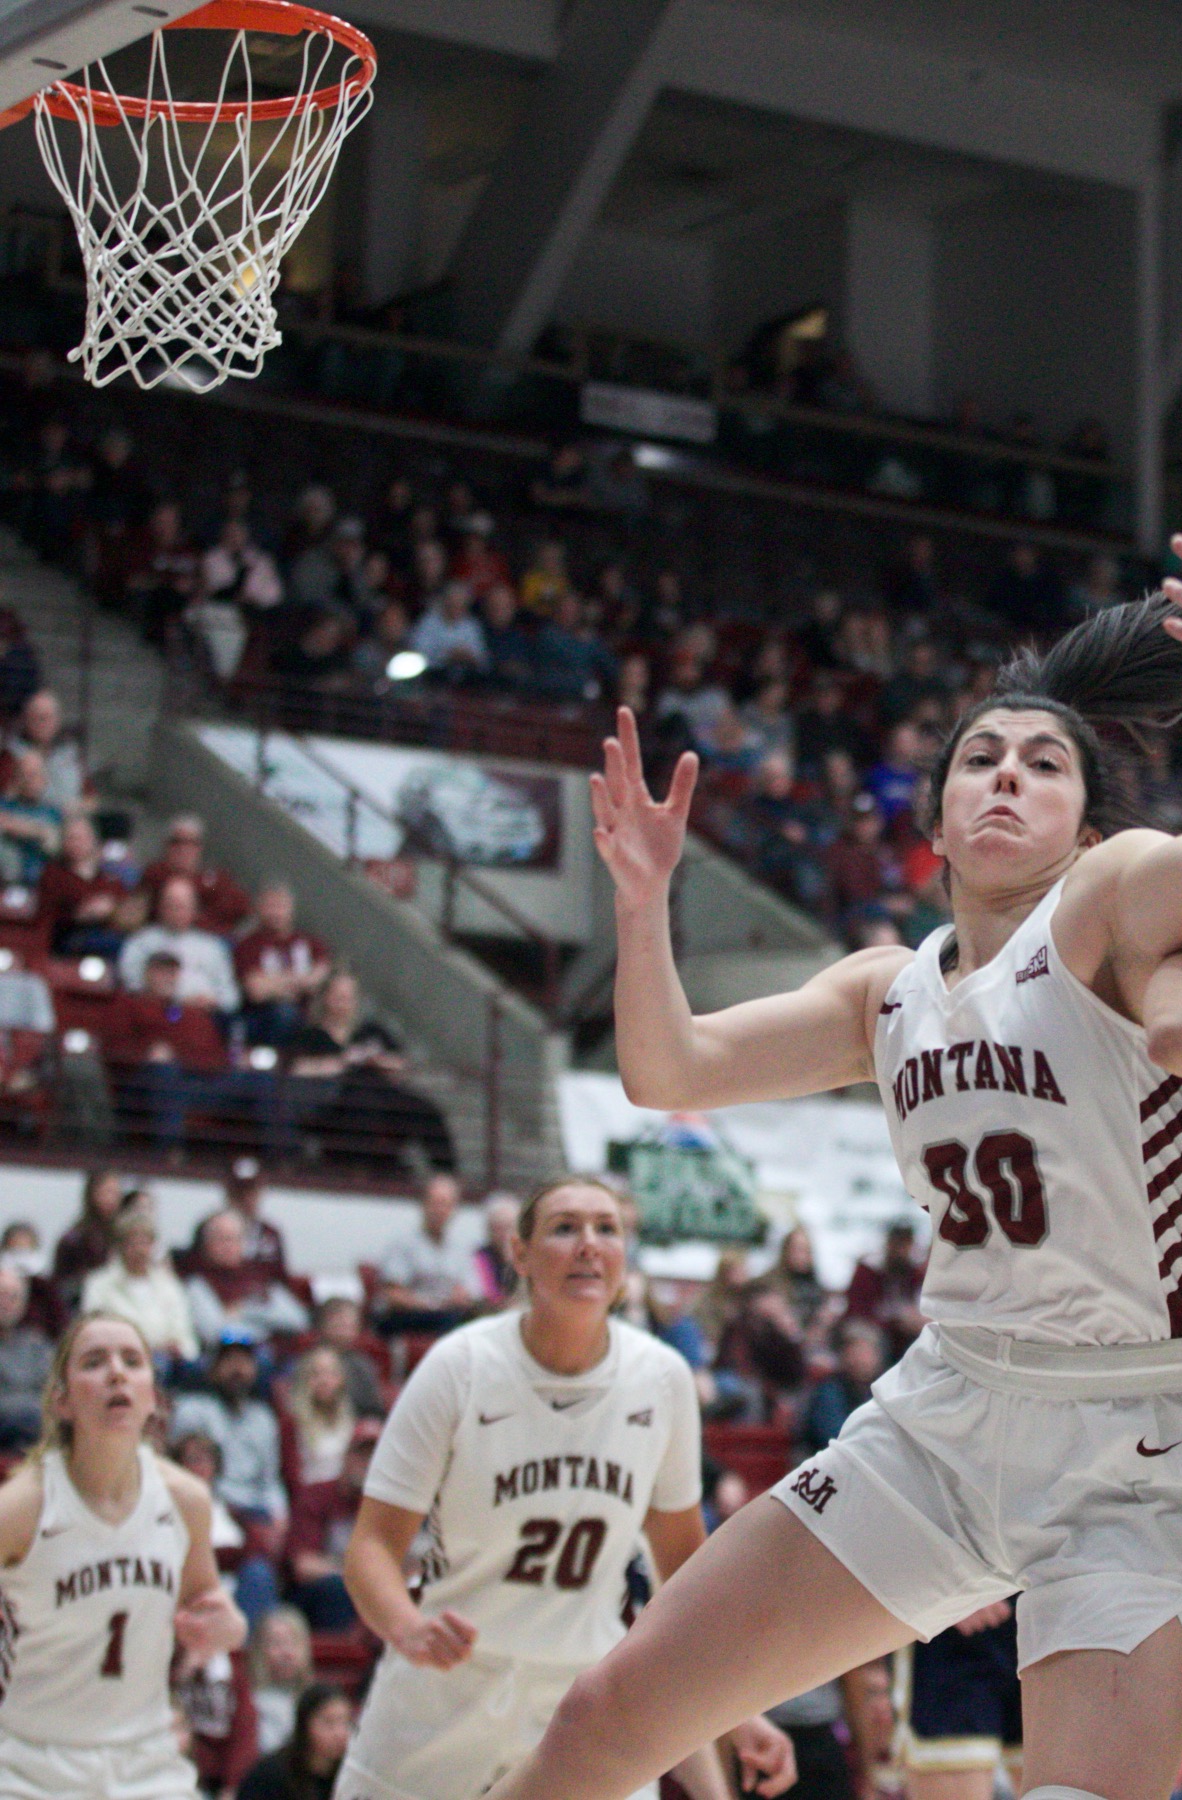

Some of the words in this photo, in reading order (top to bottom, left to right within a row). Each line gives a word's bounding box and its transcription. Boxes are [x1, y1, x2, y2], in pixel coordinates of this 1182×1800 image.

[920, 1128, 1050, 1250] 00
[503, 1517, 608, 1590] 20
[101, 1610, 129, 1679] 1
